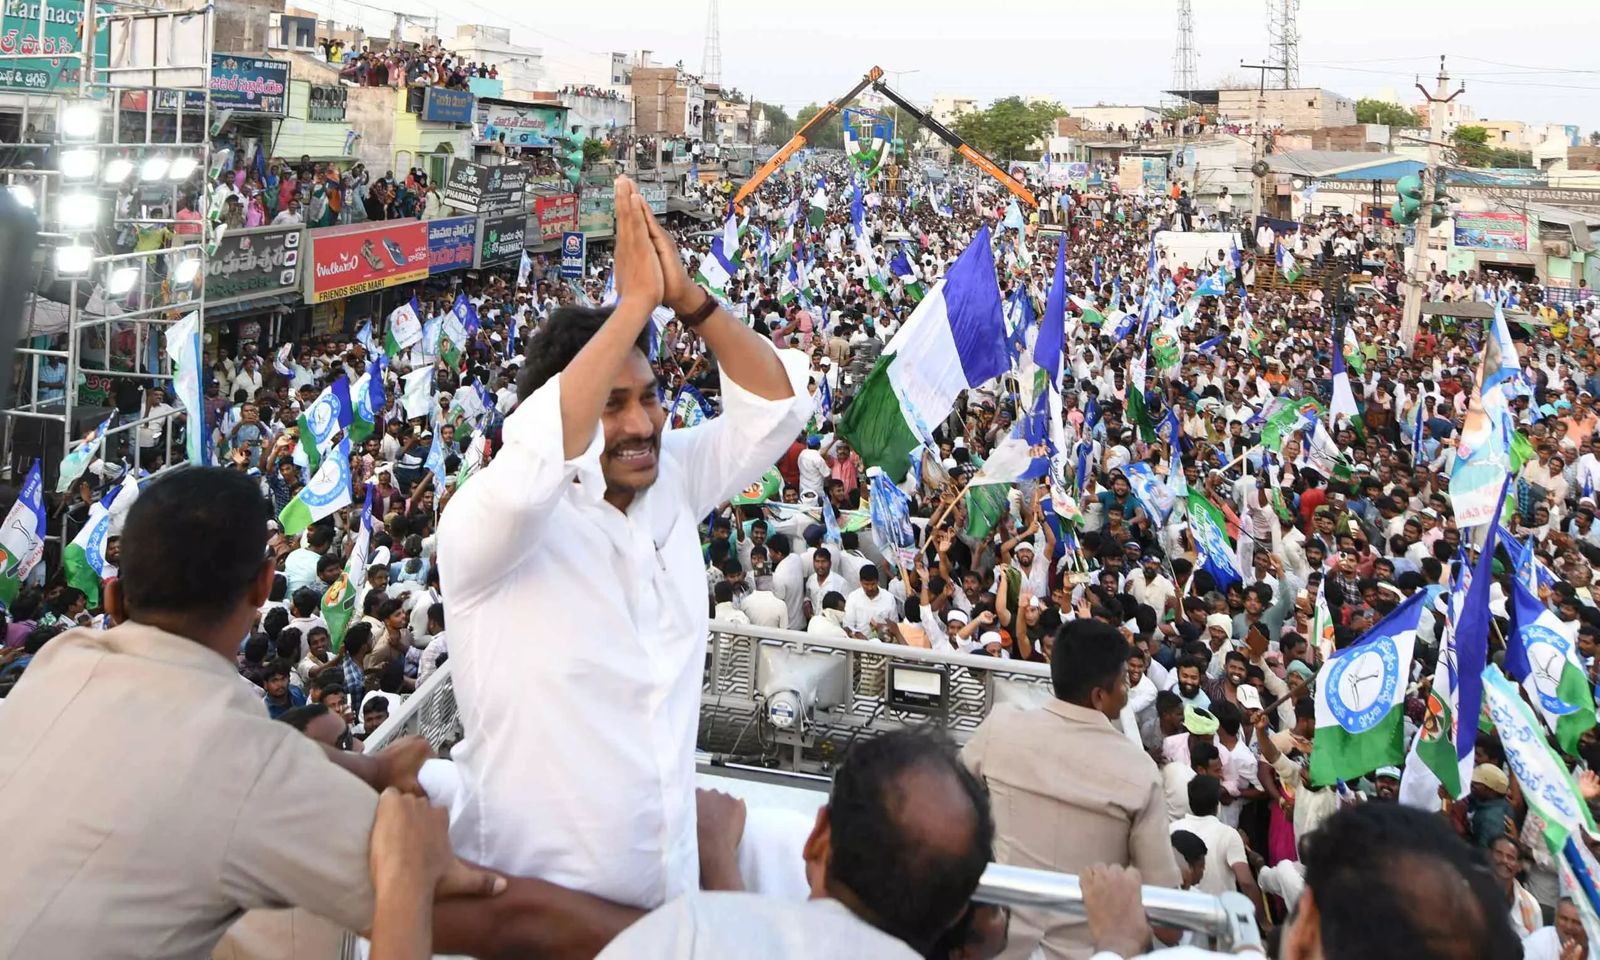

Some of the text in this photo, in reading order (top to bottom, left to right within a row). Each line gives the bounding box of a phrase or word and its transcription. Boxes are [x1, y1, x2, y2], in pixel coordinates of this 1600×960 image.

[445, 189, 480, 205] PHARMACY
[1512, 188, 1600, 201] RESTAURANT
[498, 241, 524, 256] PHARMACY
[319, 279, 385, 301] FRIENDS SHOE MART
